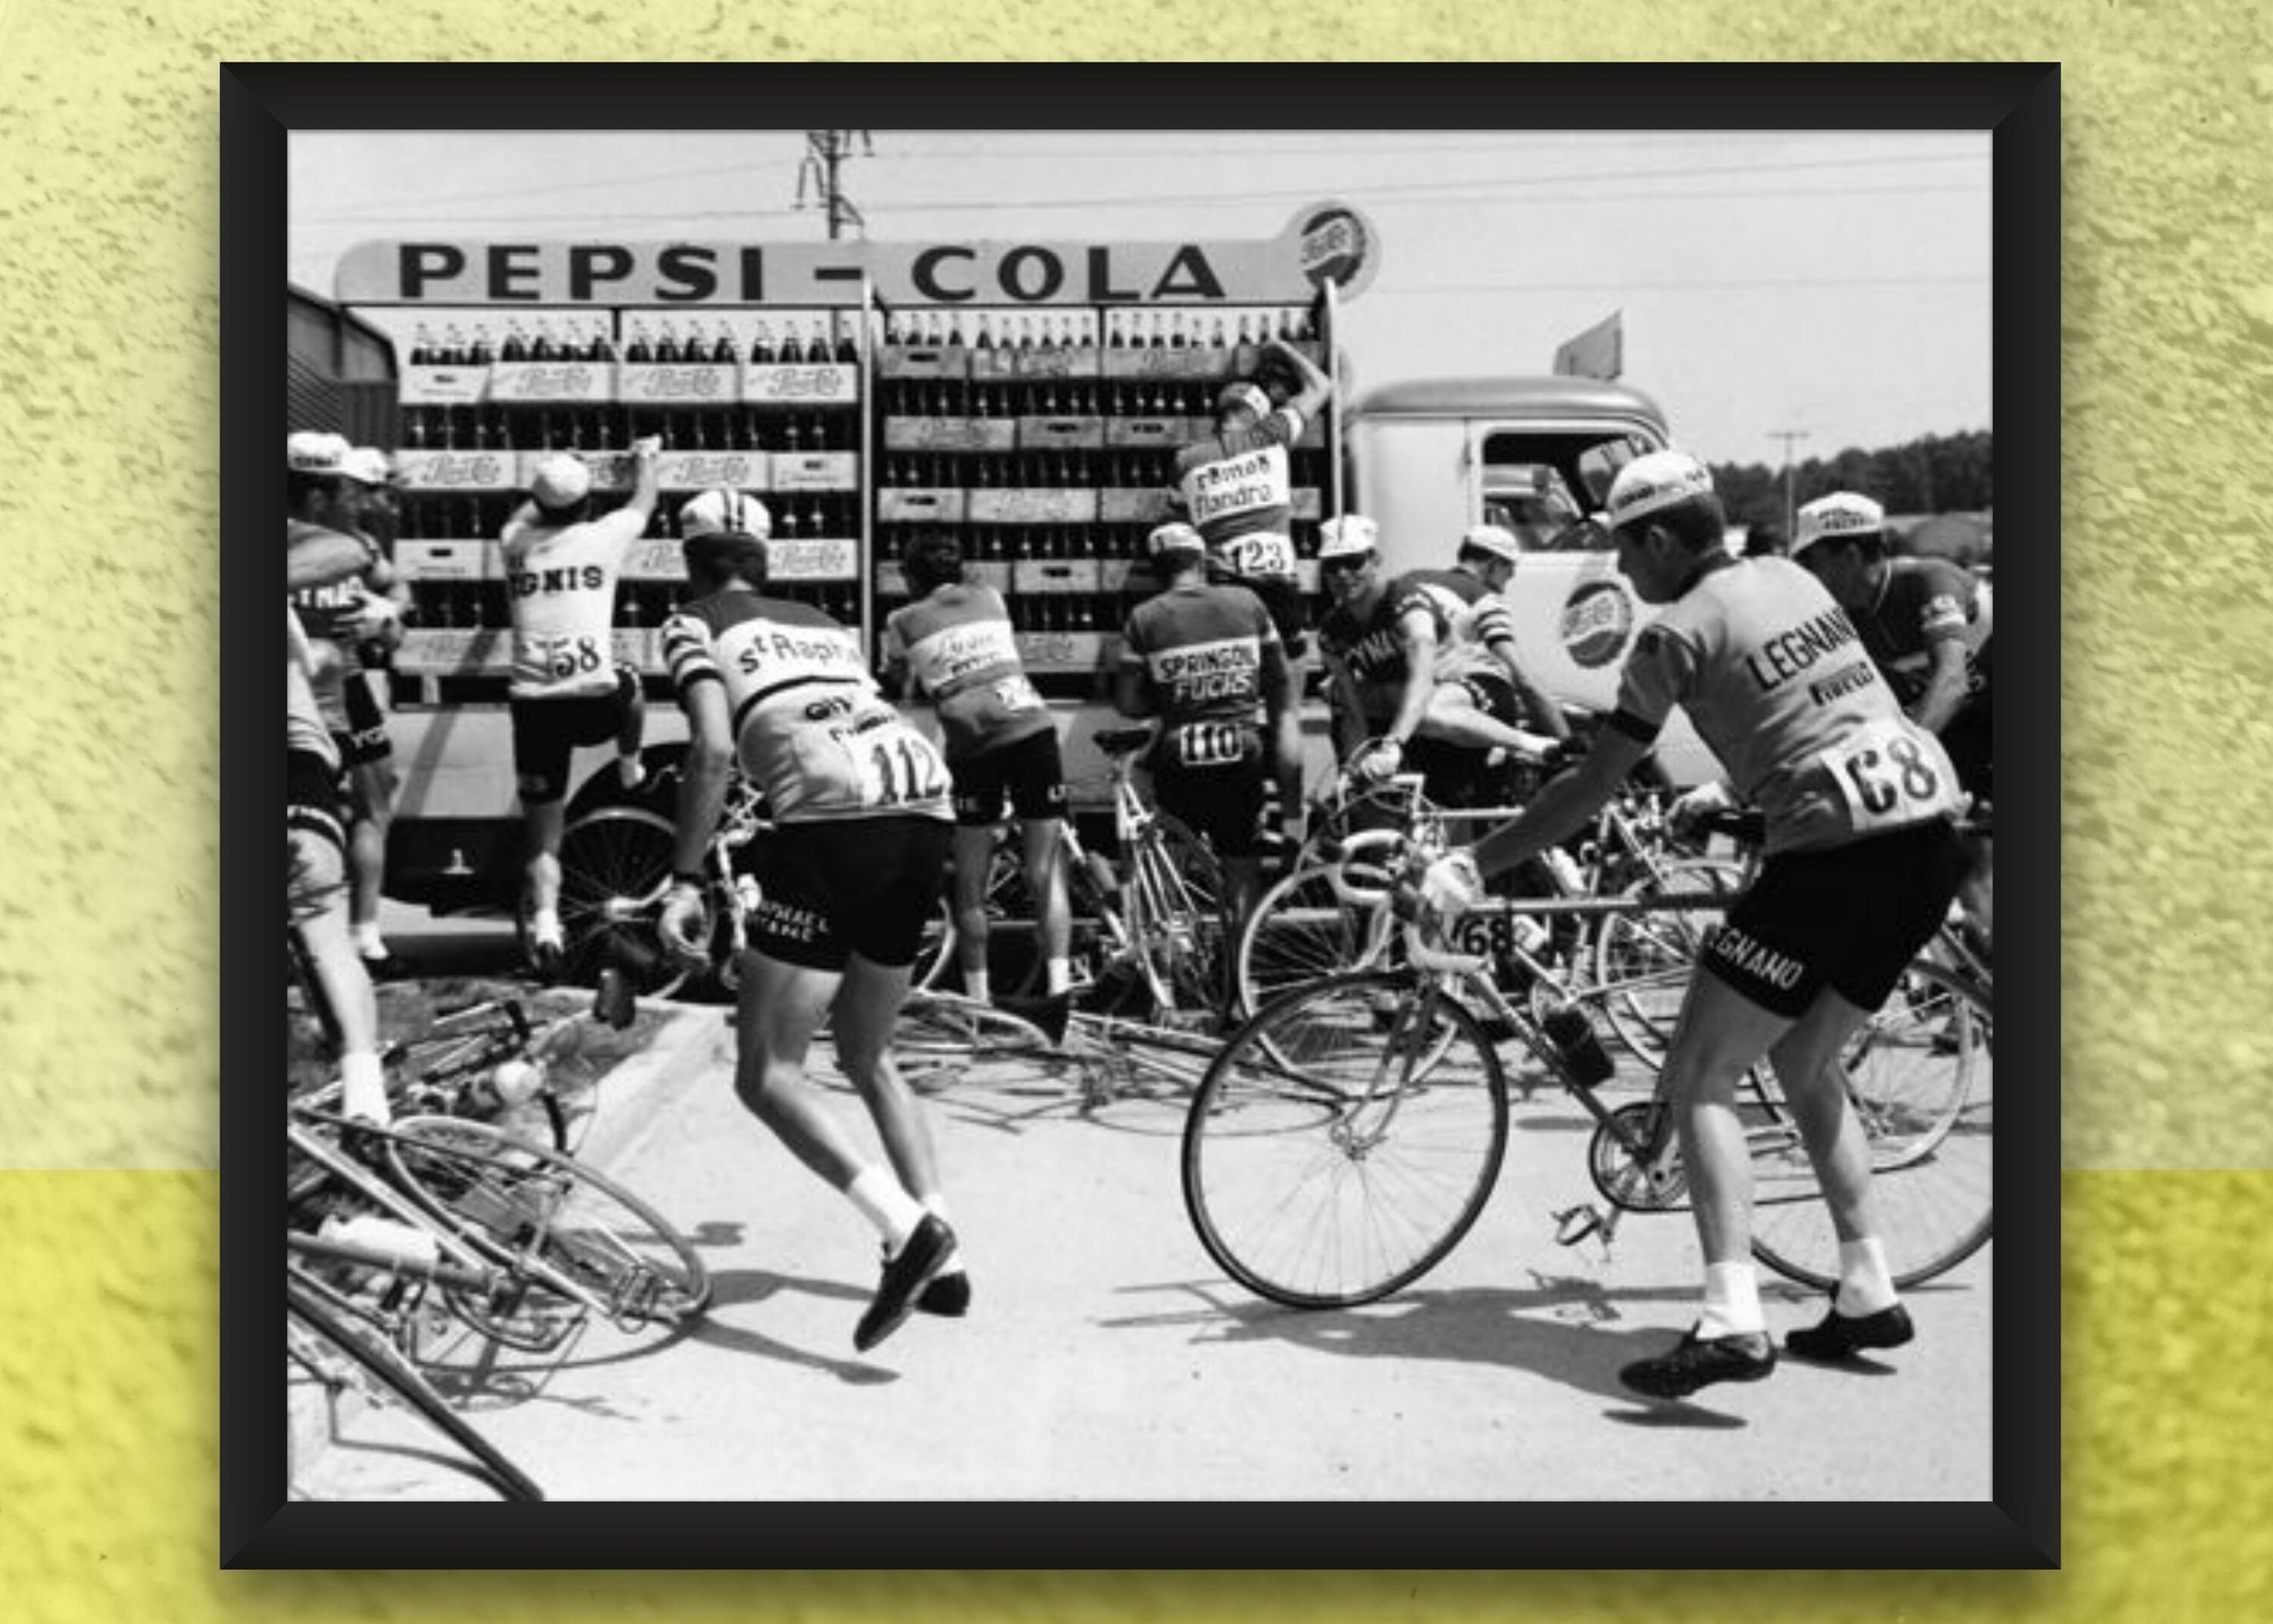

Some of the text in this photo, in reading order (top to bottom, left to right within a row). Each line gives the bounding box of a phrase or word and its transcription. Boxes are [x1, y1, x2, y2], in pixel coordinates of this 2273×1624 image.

[398, 243, 764, 301] PEPSI
[911, 244, 1226, 301] COLA
[1231, 539, 1285, 574] 123
[1187, 723, 1240, 760] 110
[871, 738, 943, 804] 112
